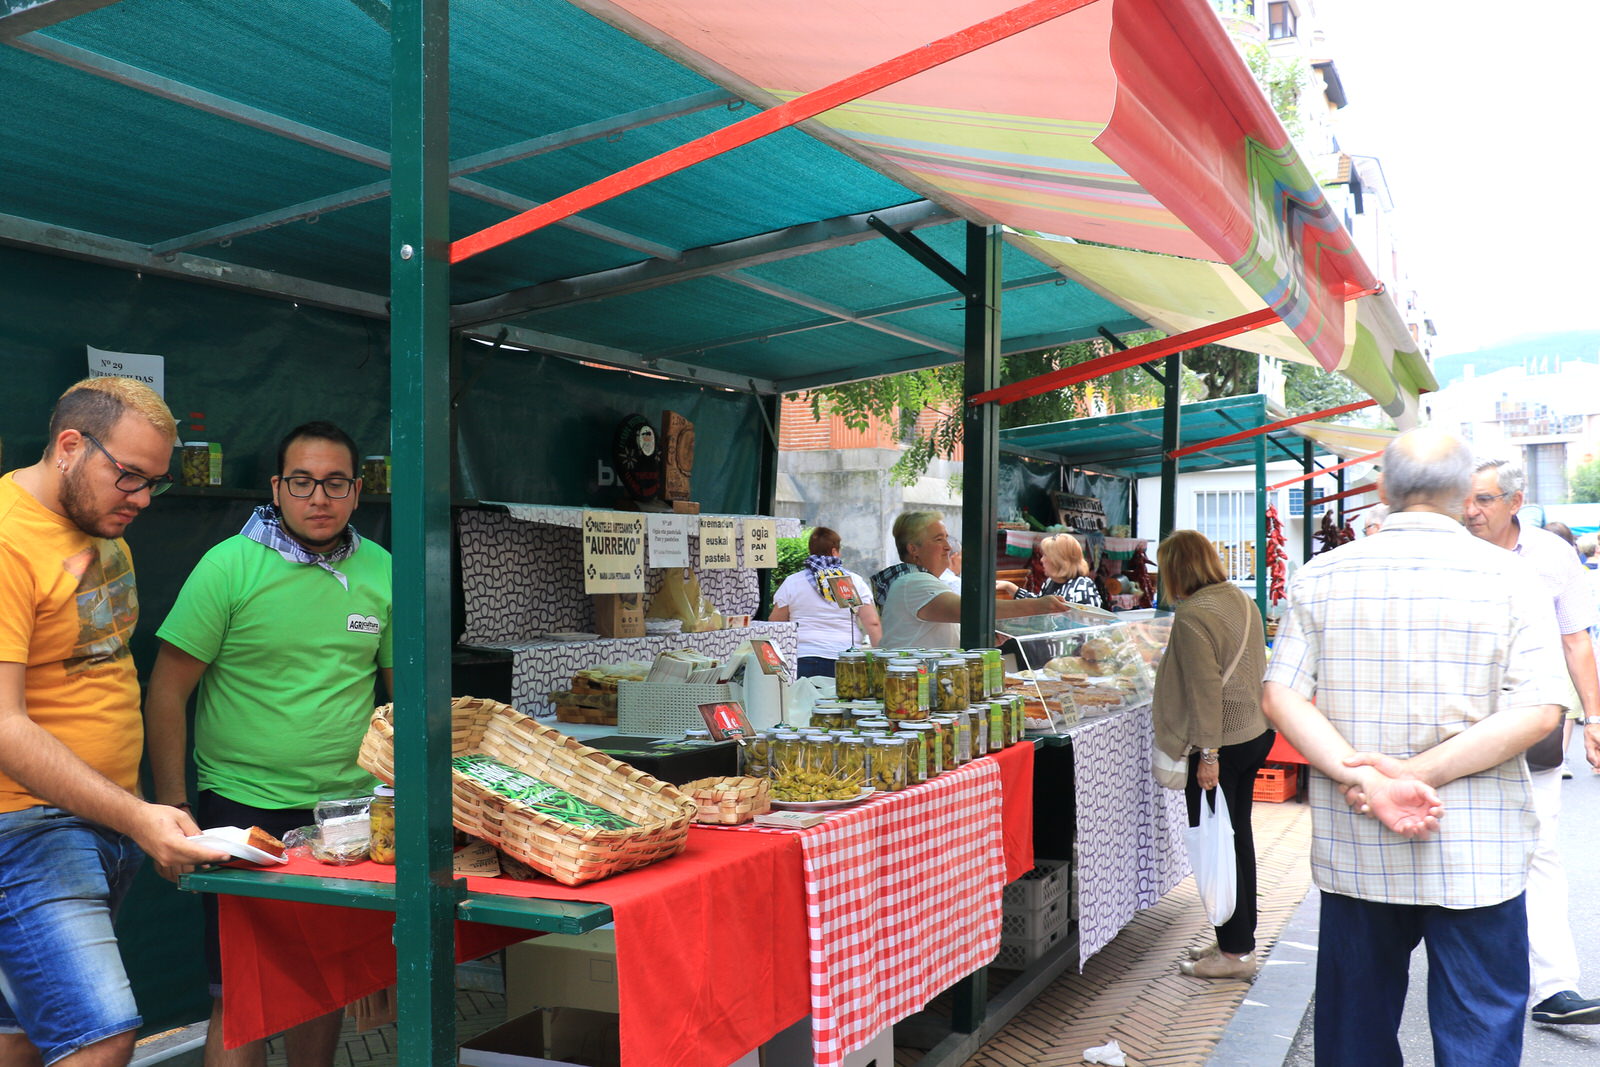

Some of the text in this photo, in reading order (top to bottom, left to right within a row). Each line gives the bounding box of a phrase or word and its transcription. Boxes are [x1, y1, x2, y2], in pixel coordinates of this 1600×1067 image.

[113, 362, 123, 370] 29
[751, 526, 769, 540] ogia
[585, 536, 640, 556] "AURREKO"
[705, 553, 731, 564] pastela
